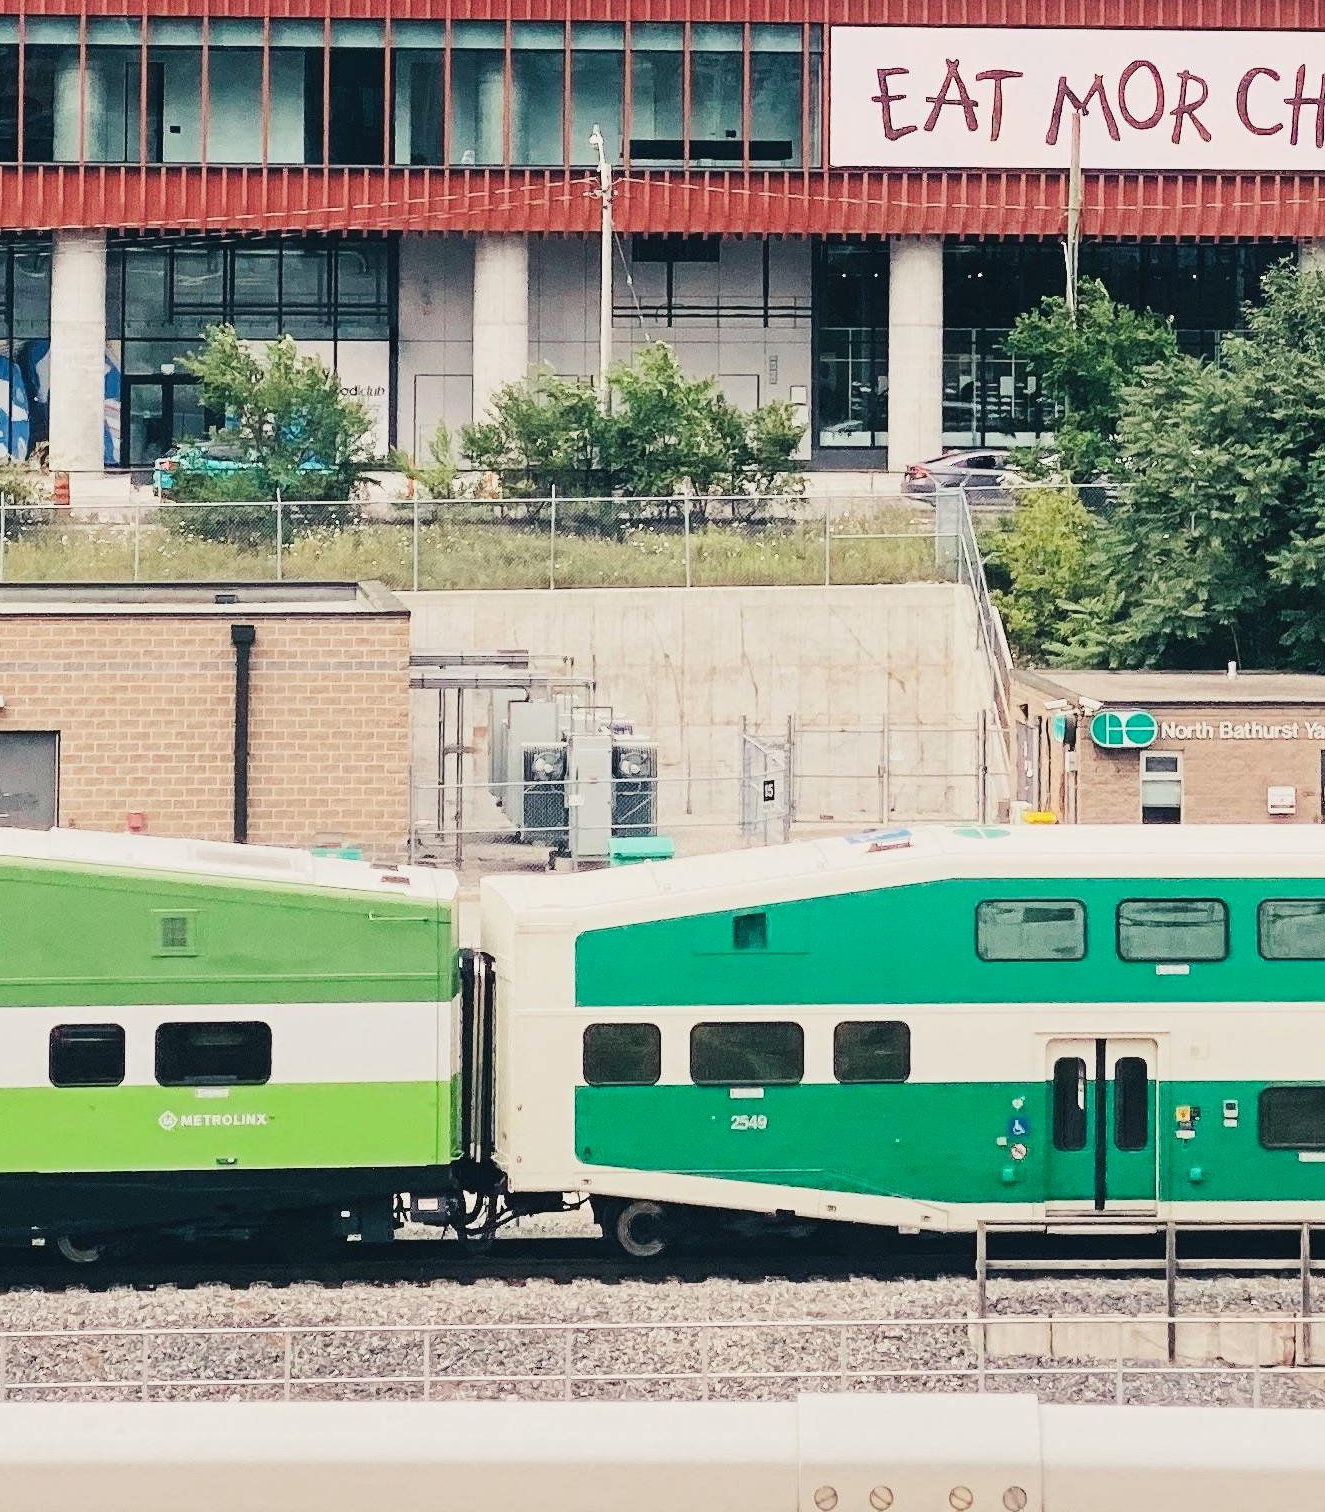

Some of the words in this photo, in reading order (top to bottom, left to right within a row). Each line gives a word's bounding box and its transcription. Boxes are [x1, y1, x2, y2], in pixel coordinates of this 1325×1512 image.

[871, 59, 1024, 142] EAT
[1046, 59, 1213, 145] MOR
[1161, 721, 1214, 740] North
[1218, 721, 1300, 740] Bathurst
[179, 1113, 268, 1127] METROLINX
